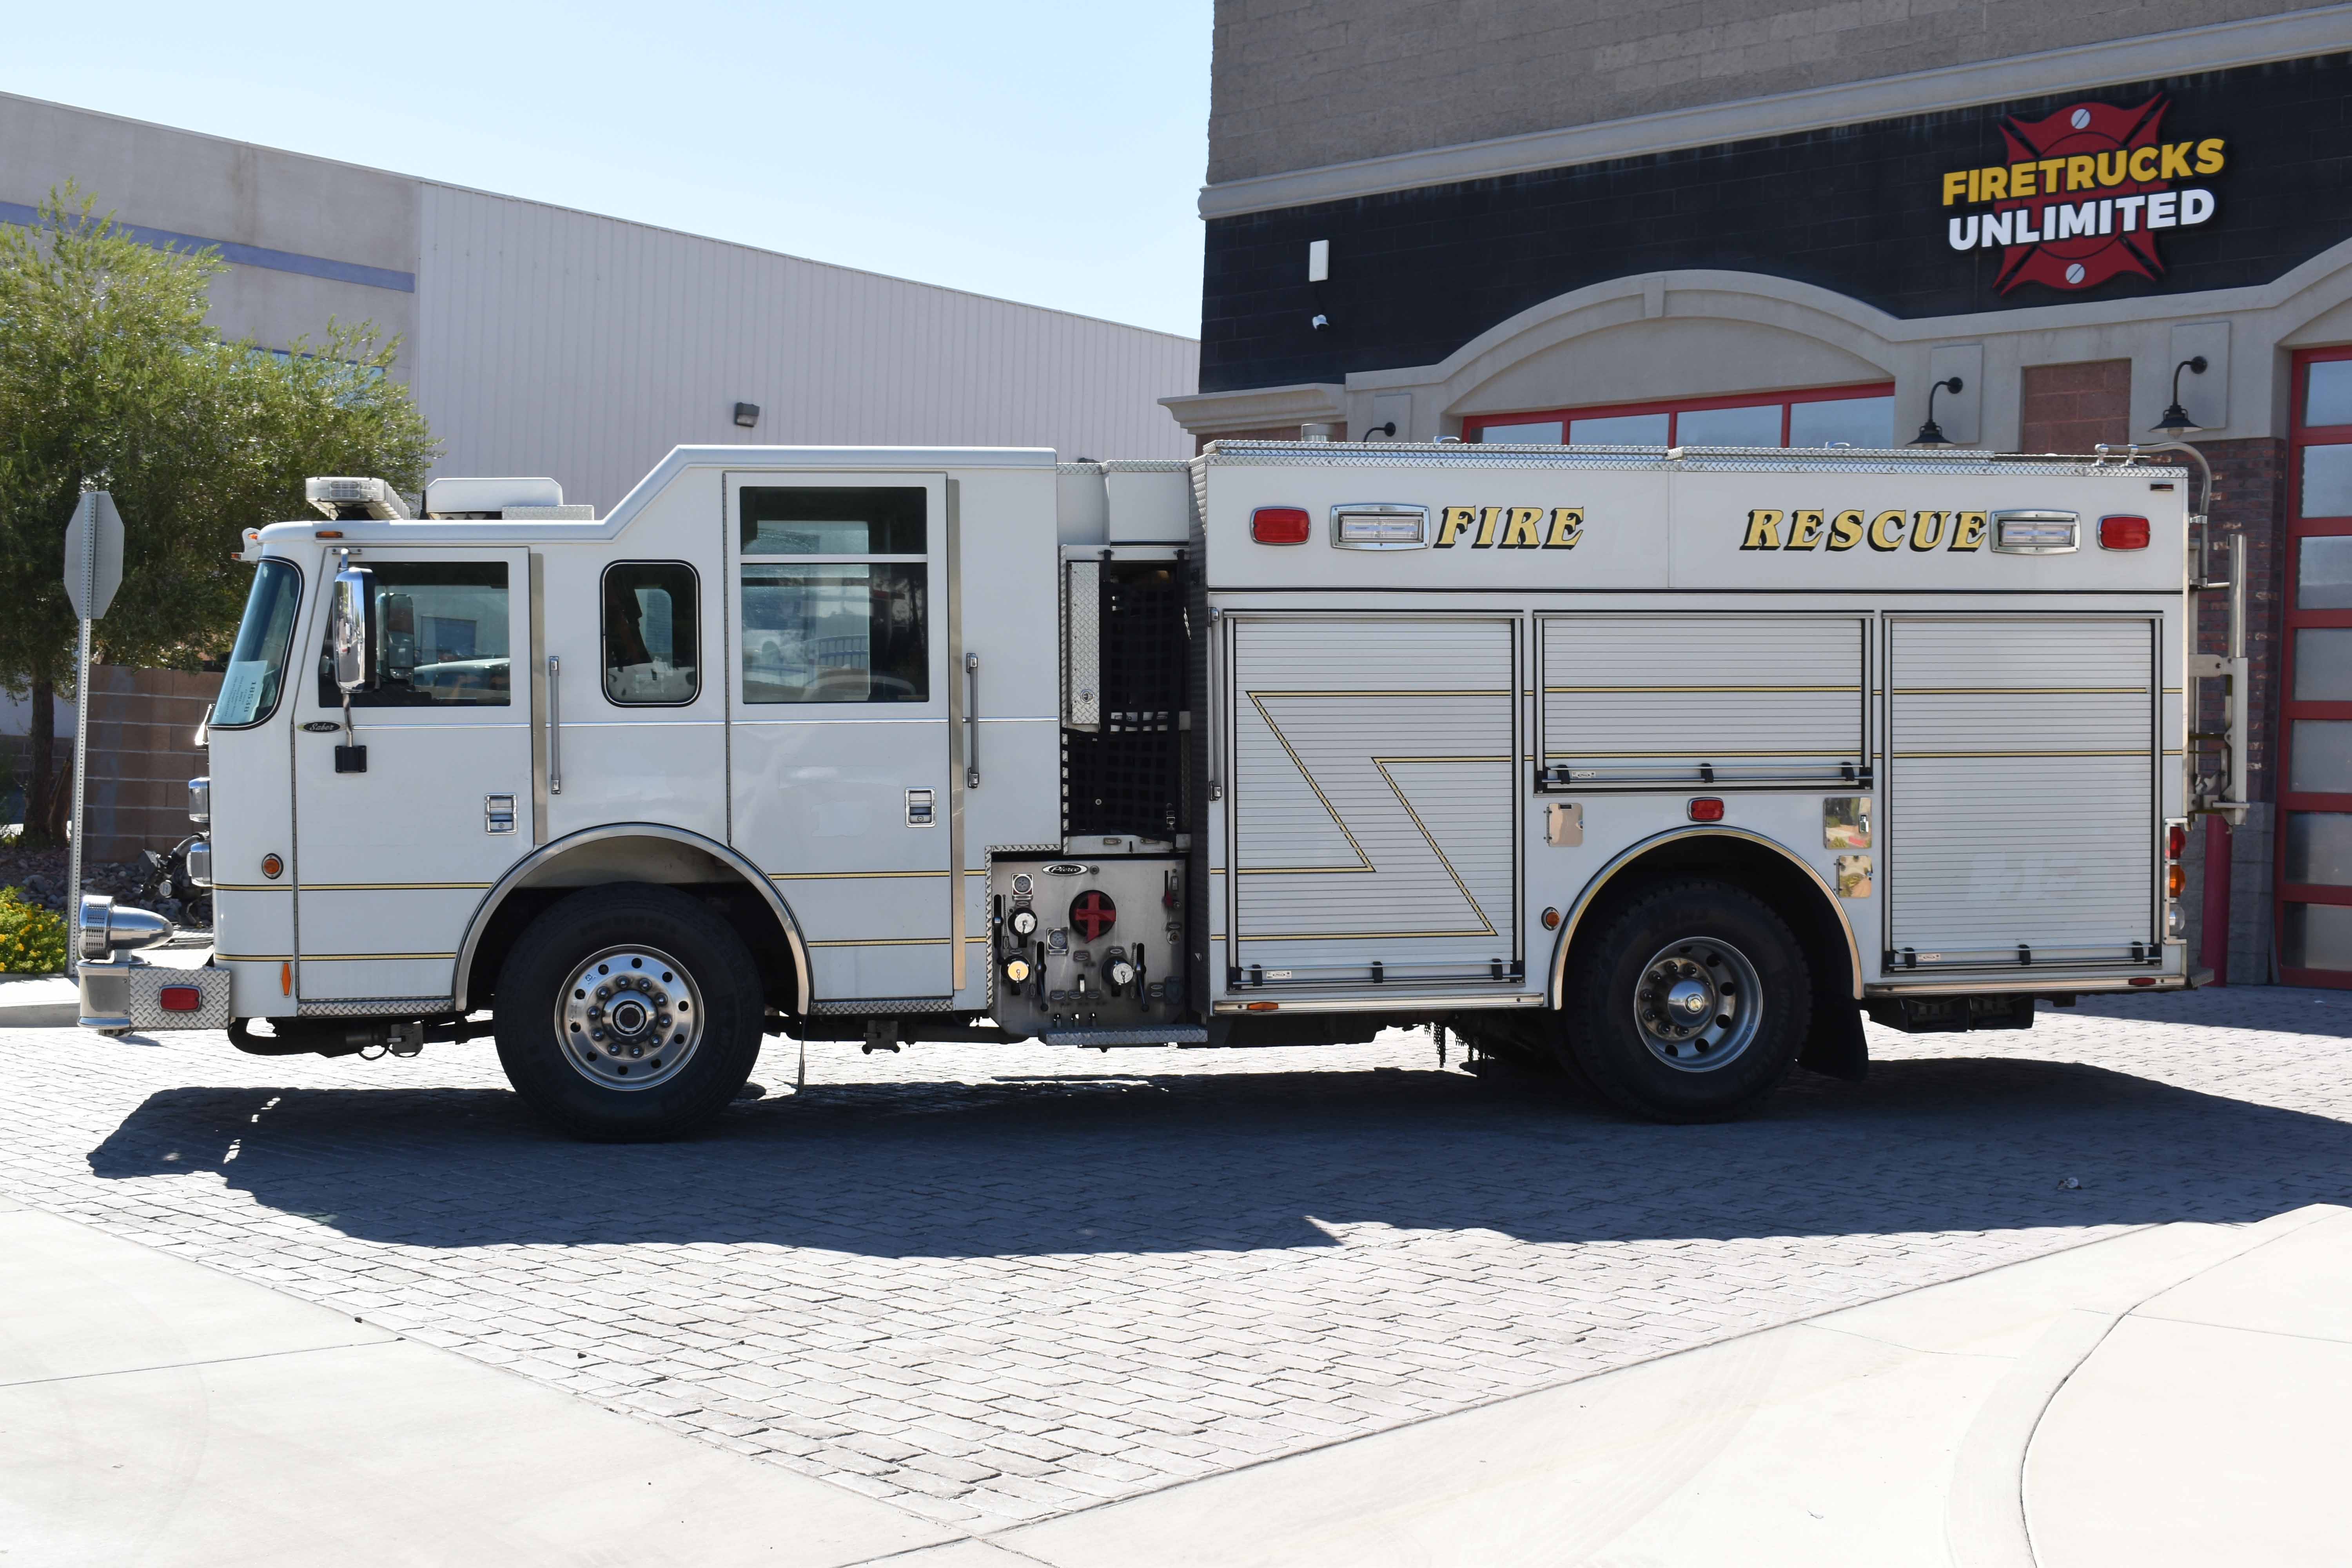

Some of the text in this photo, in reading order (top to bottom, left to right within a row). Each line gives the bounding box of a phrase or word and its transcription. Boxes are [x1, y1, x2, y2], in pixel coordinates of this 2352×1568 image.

[1942, 138, 2225, 206] FIRETRUCKS
[1949, 188, 2215, 250] UNLIMITED
[1433, 505, 1987, 552] FIRE RESCUE
[309, 722, 334, 731] Saber
